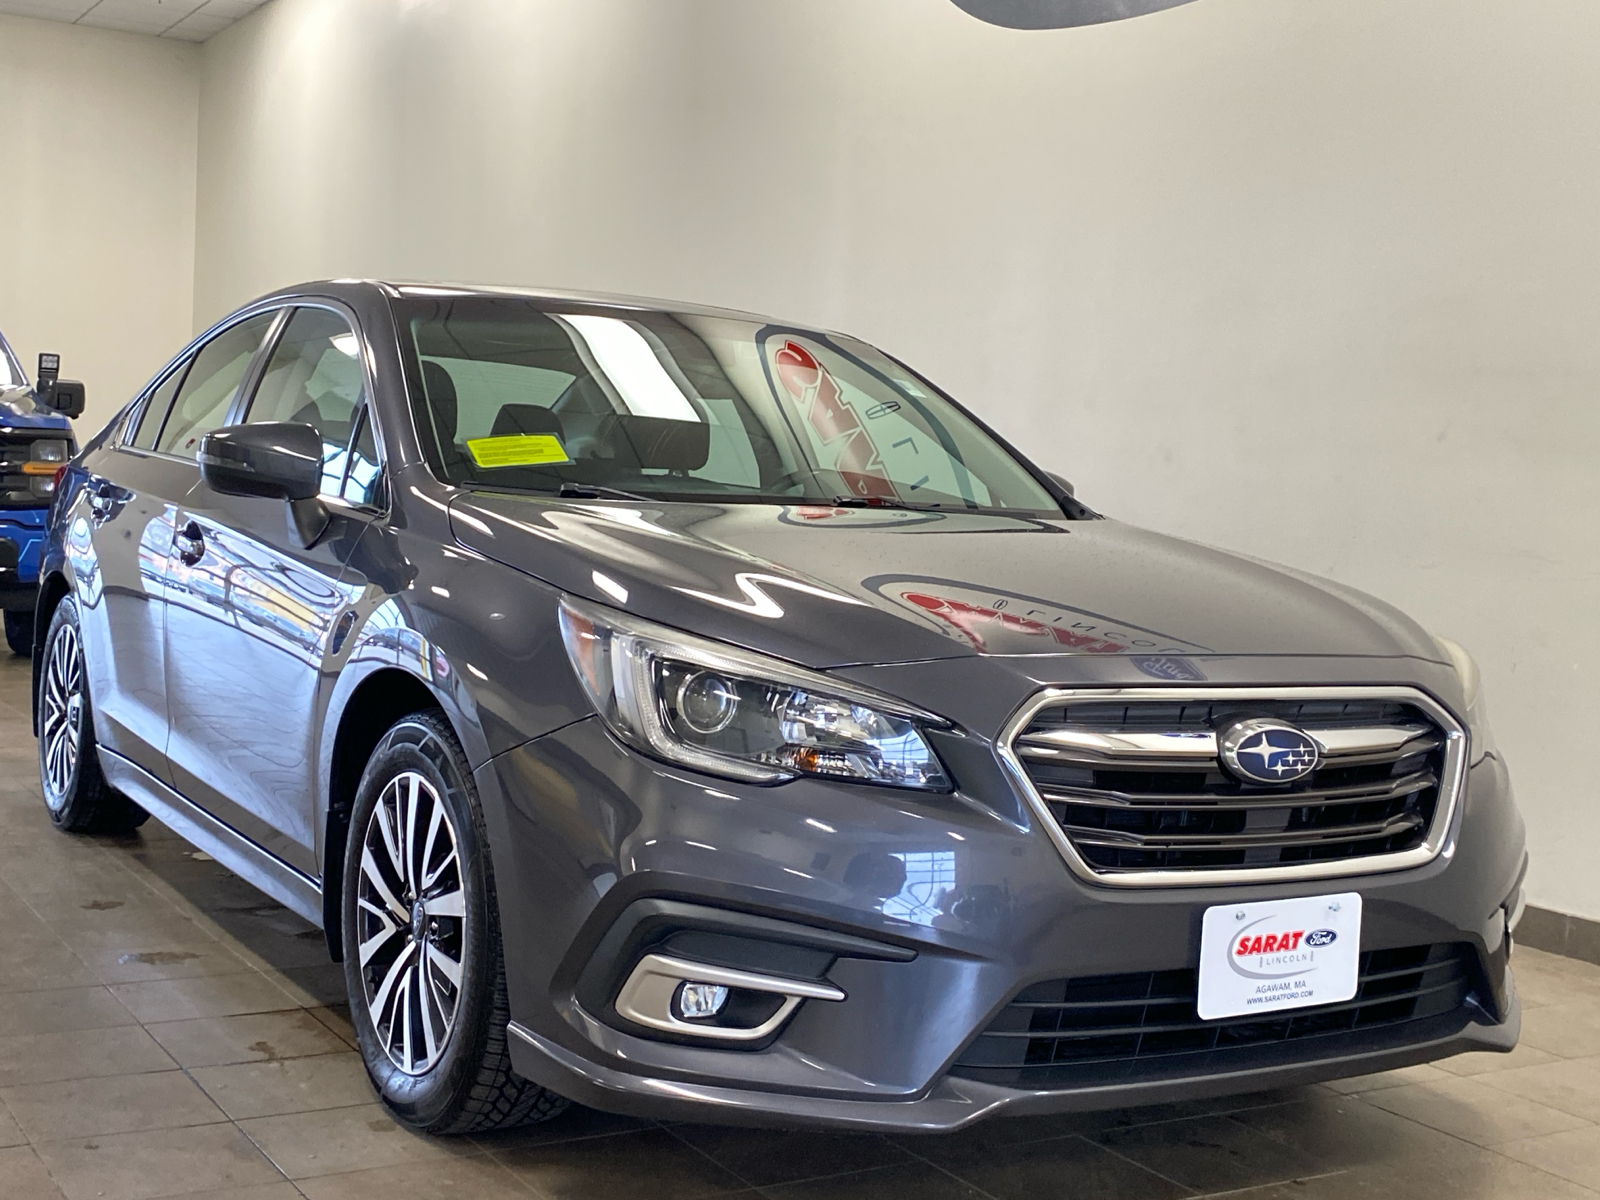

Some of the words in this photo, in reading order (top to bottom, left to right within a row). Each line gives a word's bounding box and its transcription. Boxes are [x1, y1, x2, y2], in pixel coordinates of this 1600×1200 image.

[1235, 930, 1305, 956] SARAT
[1309, 931, 1332, 946] Ford
[1266, 953, 1307, 966] LINCOLN
[1255, 982, 1292, 994] AGAWAM,
[1294, 980, 1307, 989] MA
[1246, 990, 1314, 1005] WWW.SARATFORD.COM
